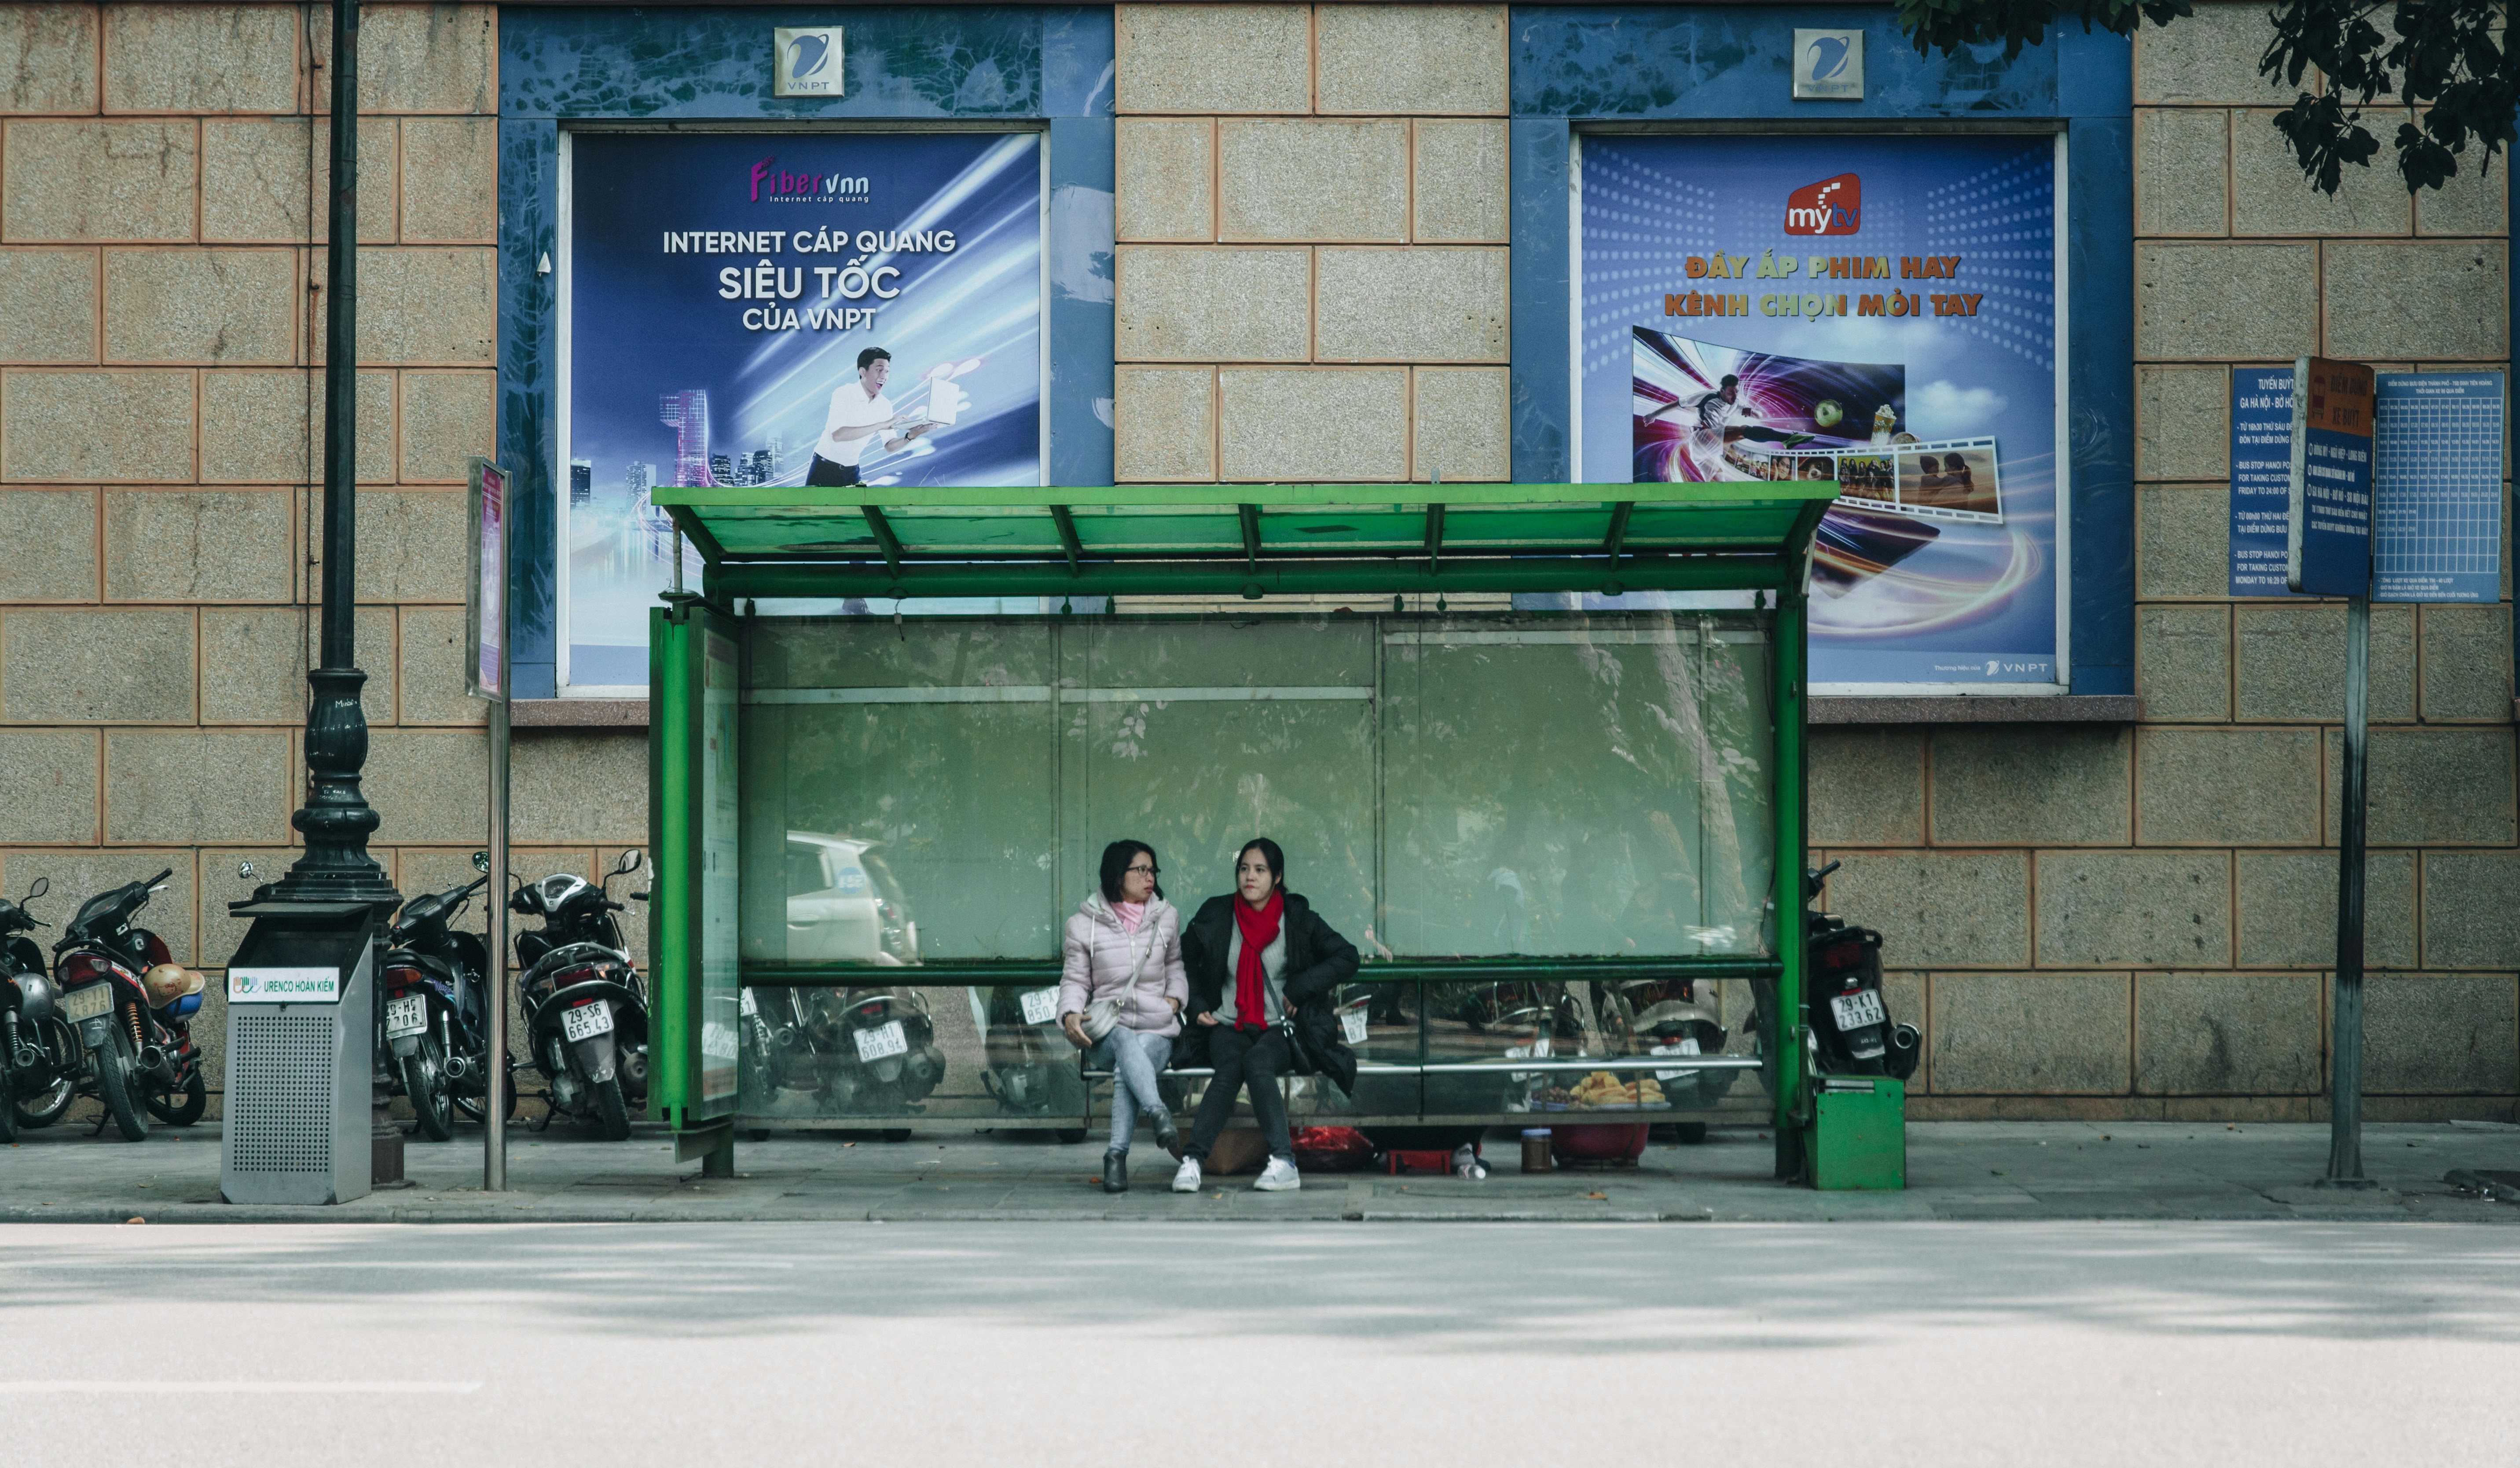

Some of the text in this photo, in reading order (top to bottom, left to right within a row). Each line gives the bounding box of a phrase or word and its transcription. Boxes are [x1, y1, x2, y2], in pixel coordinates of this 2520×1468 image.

[664, 226, 955, 253] INTERNET CÁP QUANG
[1685, 247, 1961, 279] ĐẦY ẤP PHIM HAY
[719, 255, 900, 299] SIÊU TỐC
[1665, 288, 1983, 322] KÊNH CHỌN MỎI TAY
[743, 302, 876, 330] CỦA VNPT
[2258, 375, 2277, 389] TUYẾN
[2240, 397, 2249, 408] GA
[2250, 394, 2259, 408] HÀ
[2260, 395, 2270, 411] NỘI
[2275, 394, 2284, 408] BỜ
[2274, 421, 2285, 431] SÁU
[2252, 436, 2260, 445] TẠI
[2275, 434, 2289, 444] DỪNG
[2238, 525, 2246, 535] TẠI
[2260, 523, 2275, 533] DỪNG
[2003, 664, 2047, 672] VNPT
[264, 976, 334, 992] URENCO HOÀN KIẾM
[1839, 994, 1872, 1012] 29-K1
[568, 1004, 602, 1024] 29-S6
[1839, 1007, 1882, 1028] 233.62
[569, 1017, 609, 1039] 665.43
